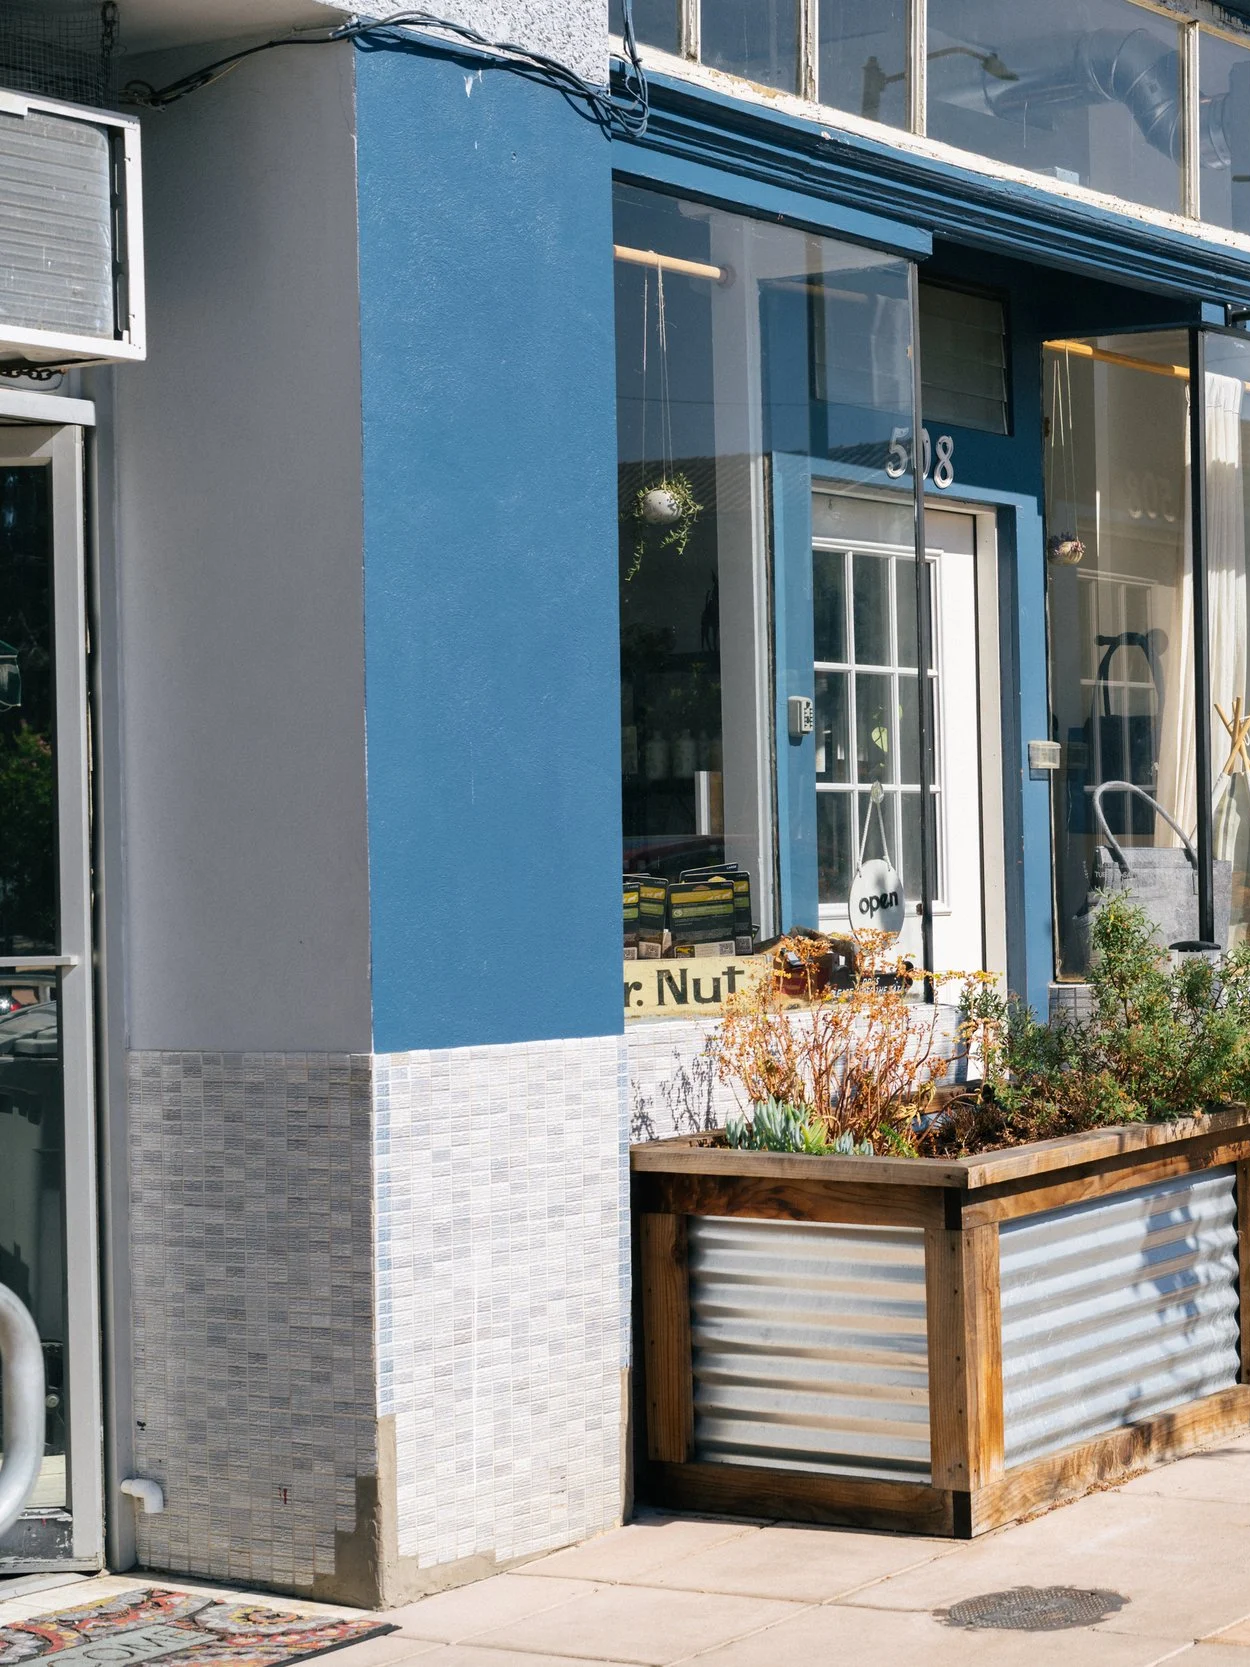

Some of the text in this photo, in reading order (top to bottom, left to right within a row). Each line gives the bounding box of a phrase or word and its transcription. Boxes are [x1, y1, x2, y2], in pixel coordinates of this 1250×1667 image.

[886, 427, 954, 490] 508
[859, 891, 899, 919] open
[656, 966, 745, 1006] Nut
